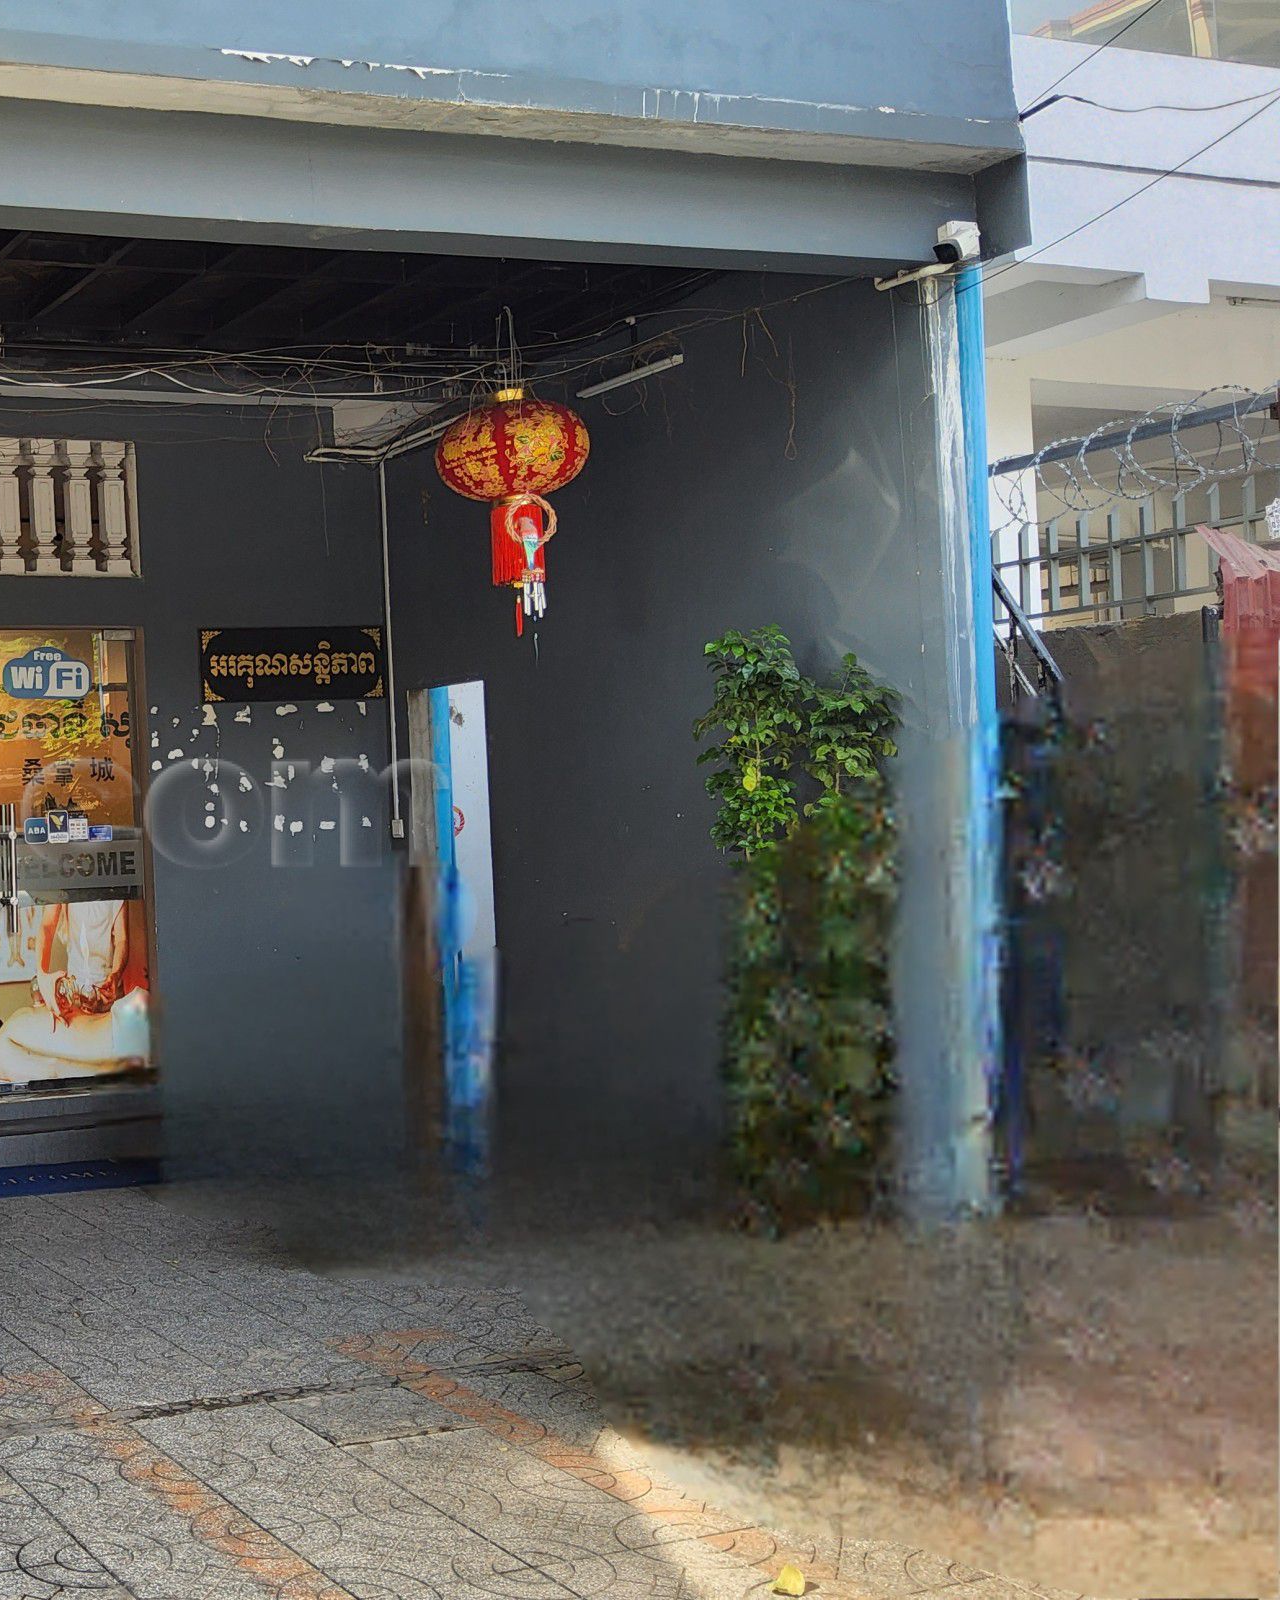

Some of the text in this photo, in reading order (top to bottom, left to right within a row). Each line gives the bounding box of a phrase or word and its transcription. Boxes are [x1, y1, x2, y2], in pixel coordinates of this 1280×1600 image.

[33, 651, 62, 661] Free
[209, 640, 376, 689] អរគុណសន្តិភាព
[27, 827, 46, 835] ABA
